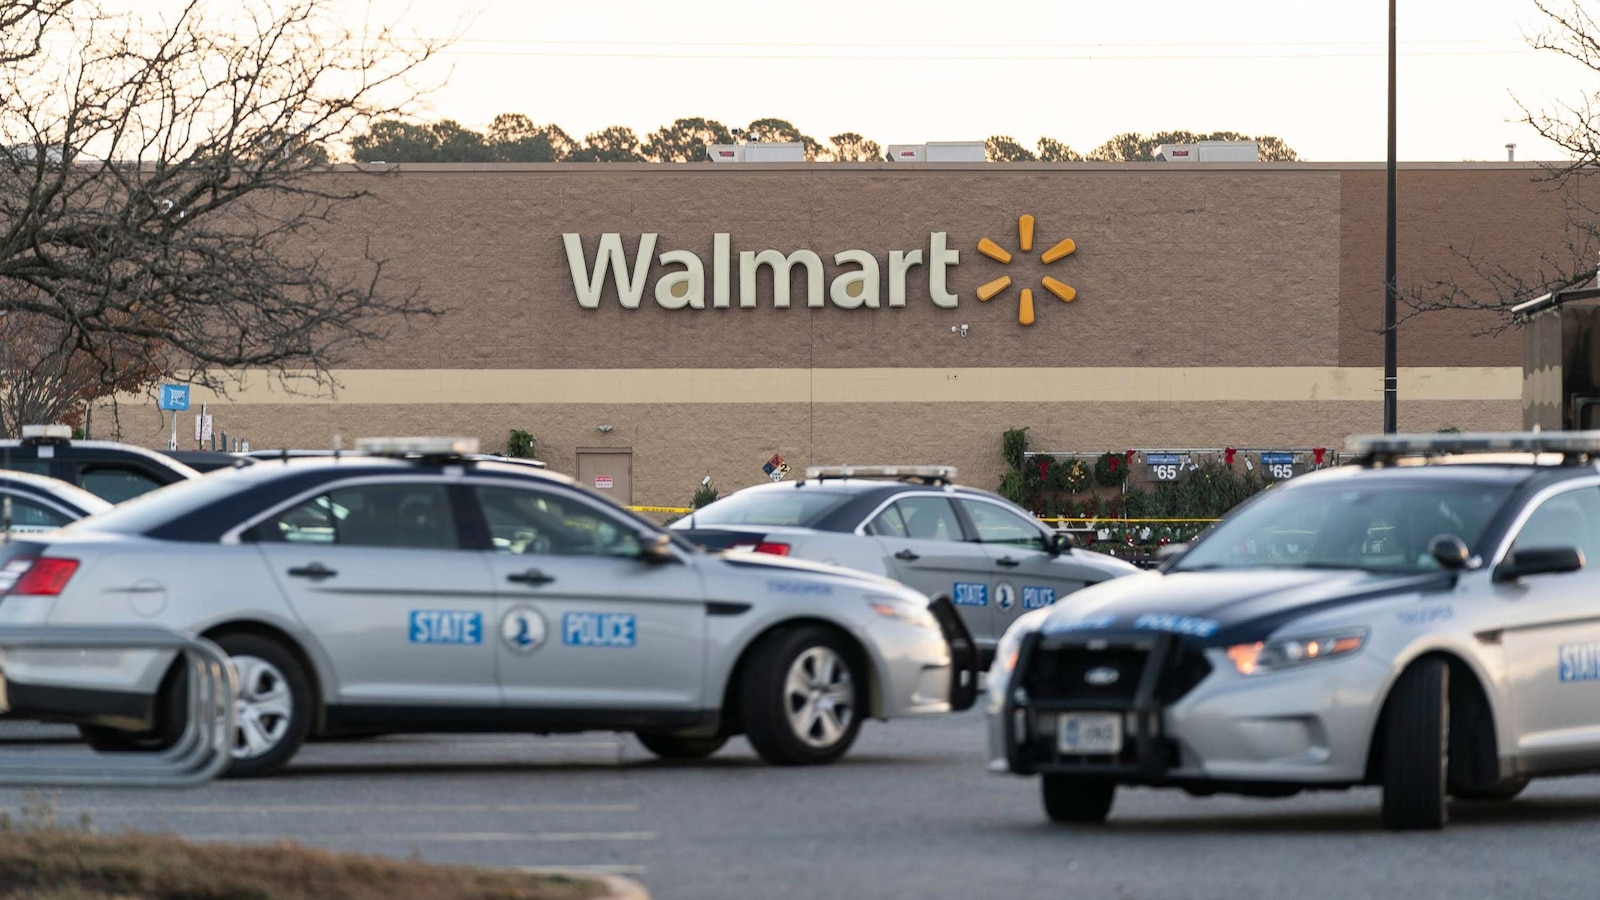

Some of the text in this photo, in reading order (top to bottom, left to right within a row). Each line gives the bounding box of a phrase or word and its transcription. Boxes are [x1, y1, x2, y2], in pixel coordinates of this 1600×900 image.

[562, 231, 960, 309] Walmart
[780, 463, 788, 473] 2
[1153, 465, 1177, 480] $65
[1269, 464, 1293, 479] $65
[955, 583, 1055, 608] STATE POLICE
[414, 611, 634, 646] STATE POLICE
